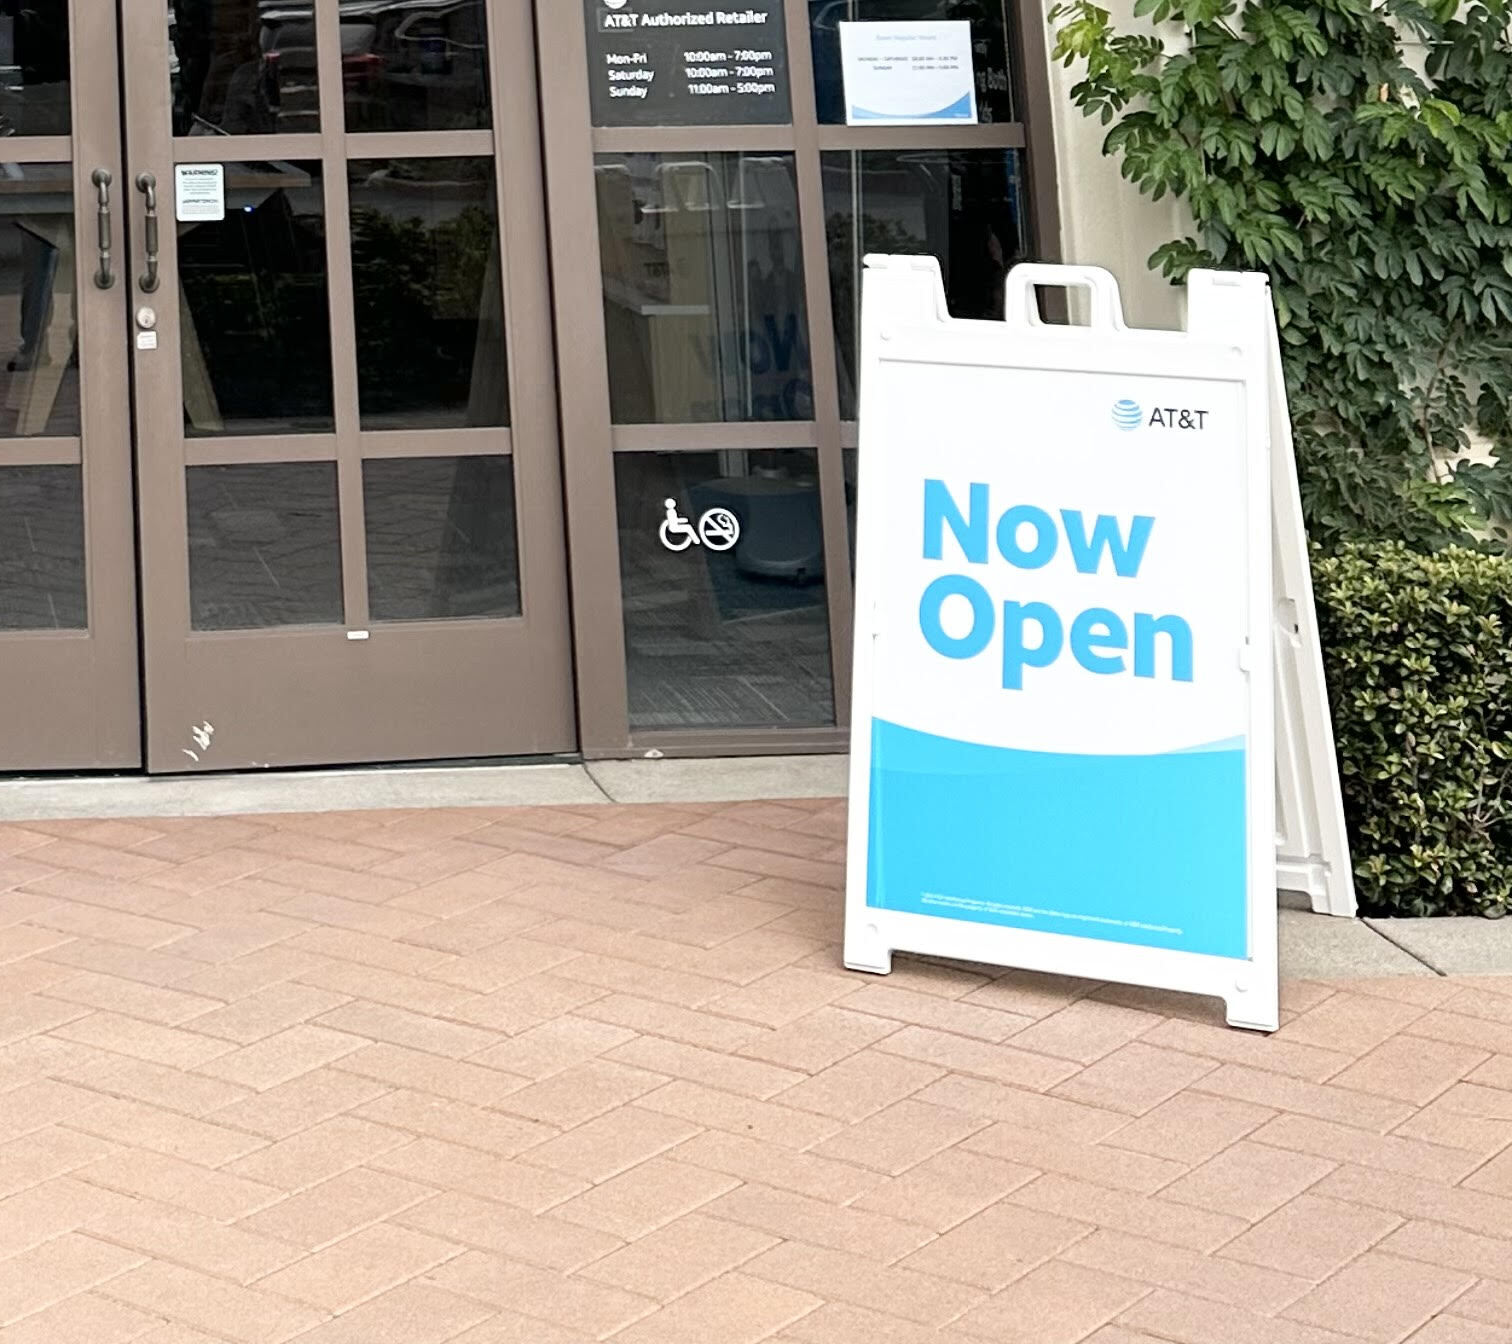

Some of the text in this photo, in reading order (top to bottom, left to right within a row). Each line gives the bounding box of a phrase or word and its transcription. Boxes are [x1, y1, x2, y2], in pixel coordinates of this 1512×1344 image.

[604, 10, 768, 28] AT&T Authorized Retailer
[606, 52, 648, 64] Mon-Fri
[684, 51, 727, 63] 10:00am
[734, 50, 772, 63] 7:00pm
[608, 69, 655, 82] Saturday
[685, 67, 728, 78] 10:00am
[736, 66, 774, 79] 7:00pm
[609, 85, 648, 99] Sunday
[1148, 407, 1209, 430] AT&T
[921, 478, 1156, 578] Now
[919, 574, 1194, 691] Open
